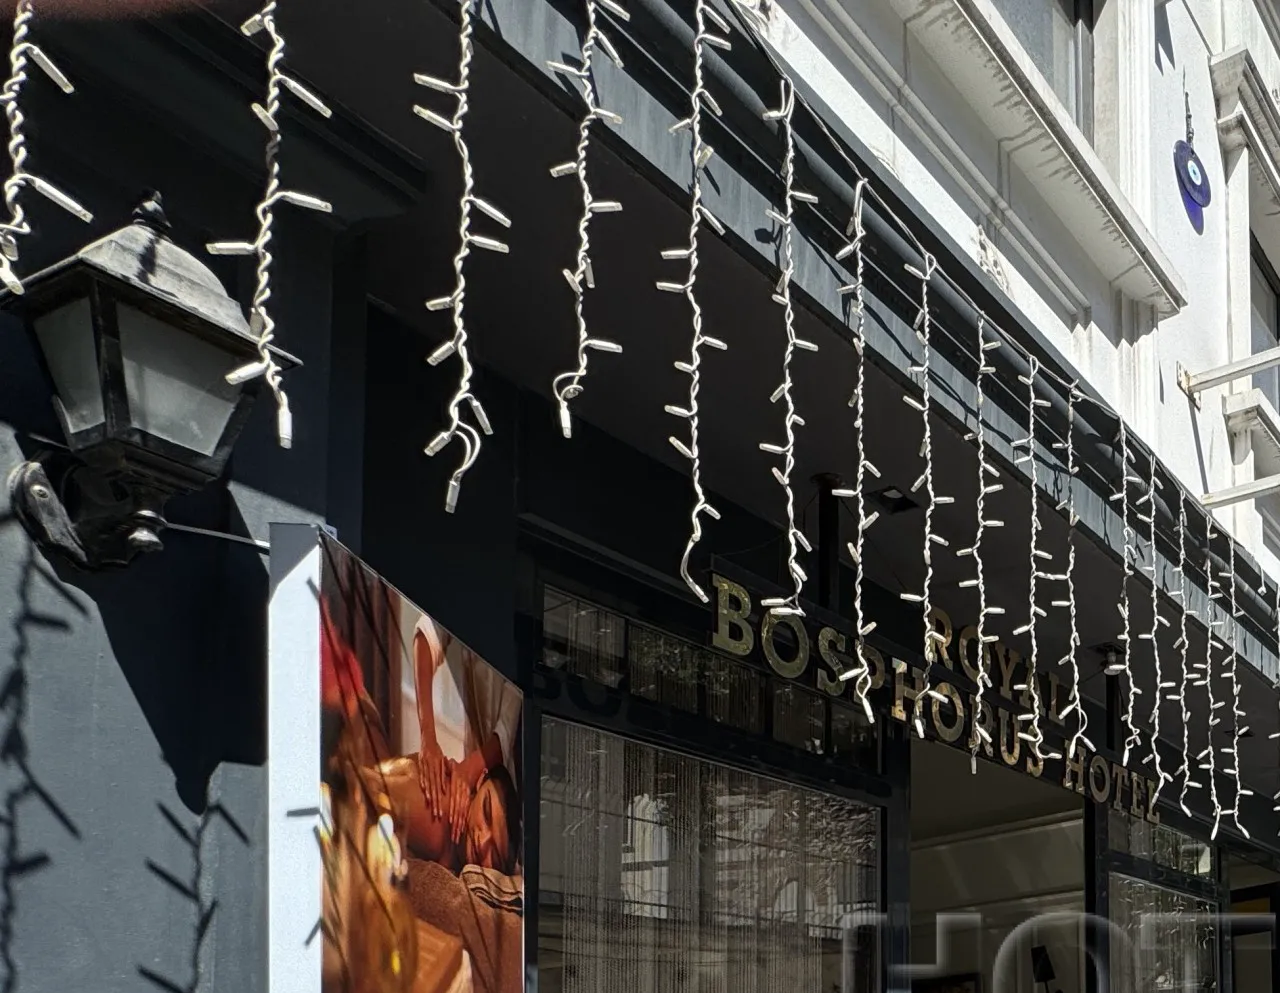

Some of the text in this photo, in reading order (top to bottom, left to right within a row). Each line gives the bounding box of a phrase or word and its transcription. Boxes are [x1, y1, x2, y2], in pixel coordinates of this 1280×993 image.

[712, 573, 1160, 824] BOSPHORUS HOTEL
[926, 605, 1066, 721] ROYAL
